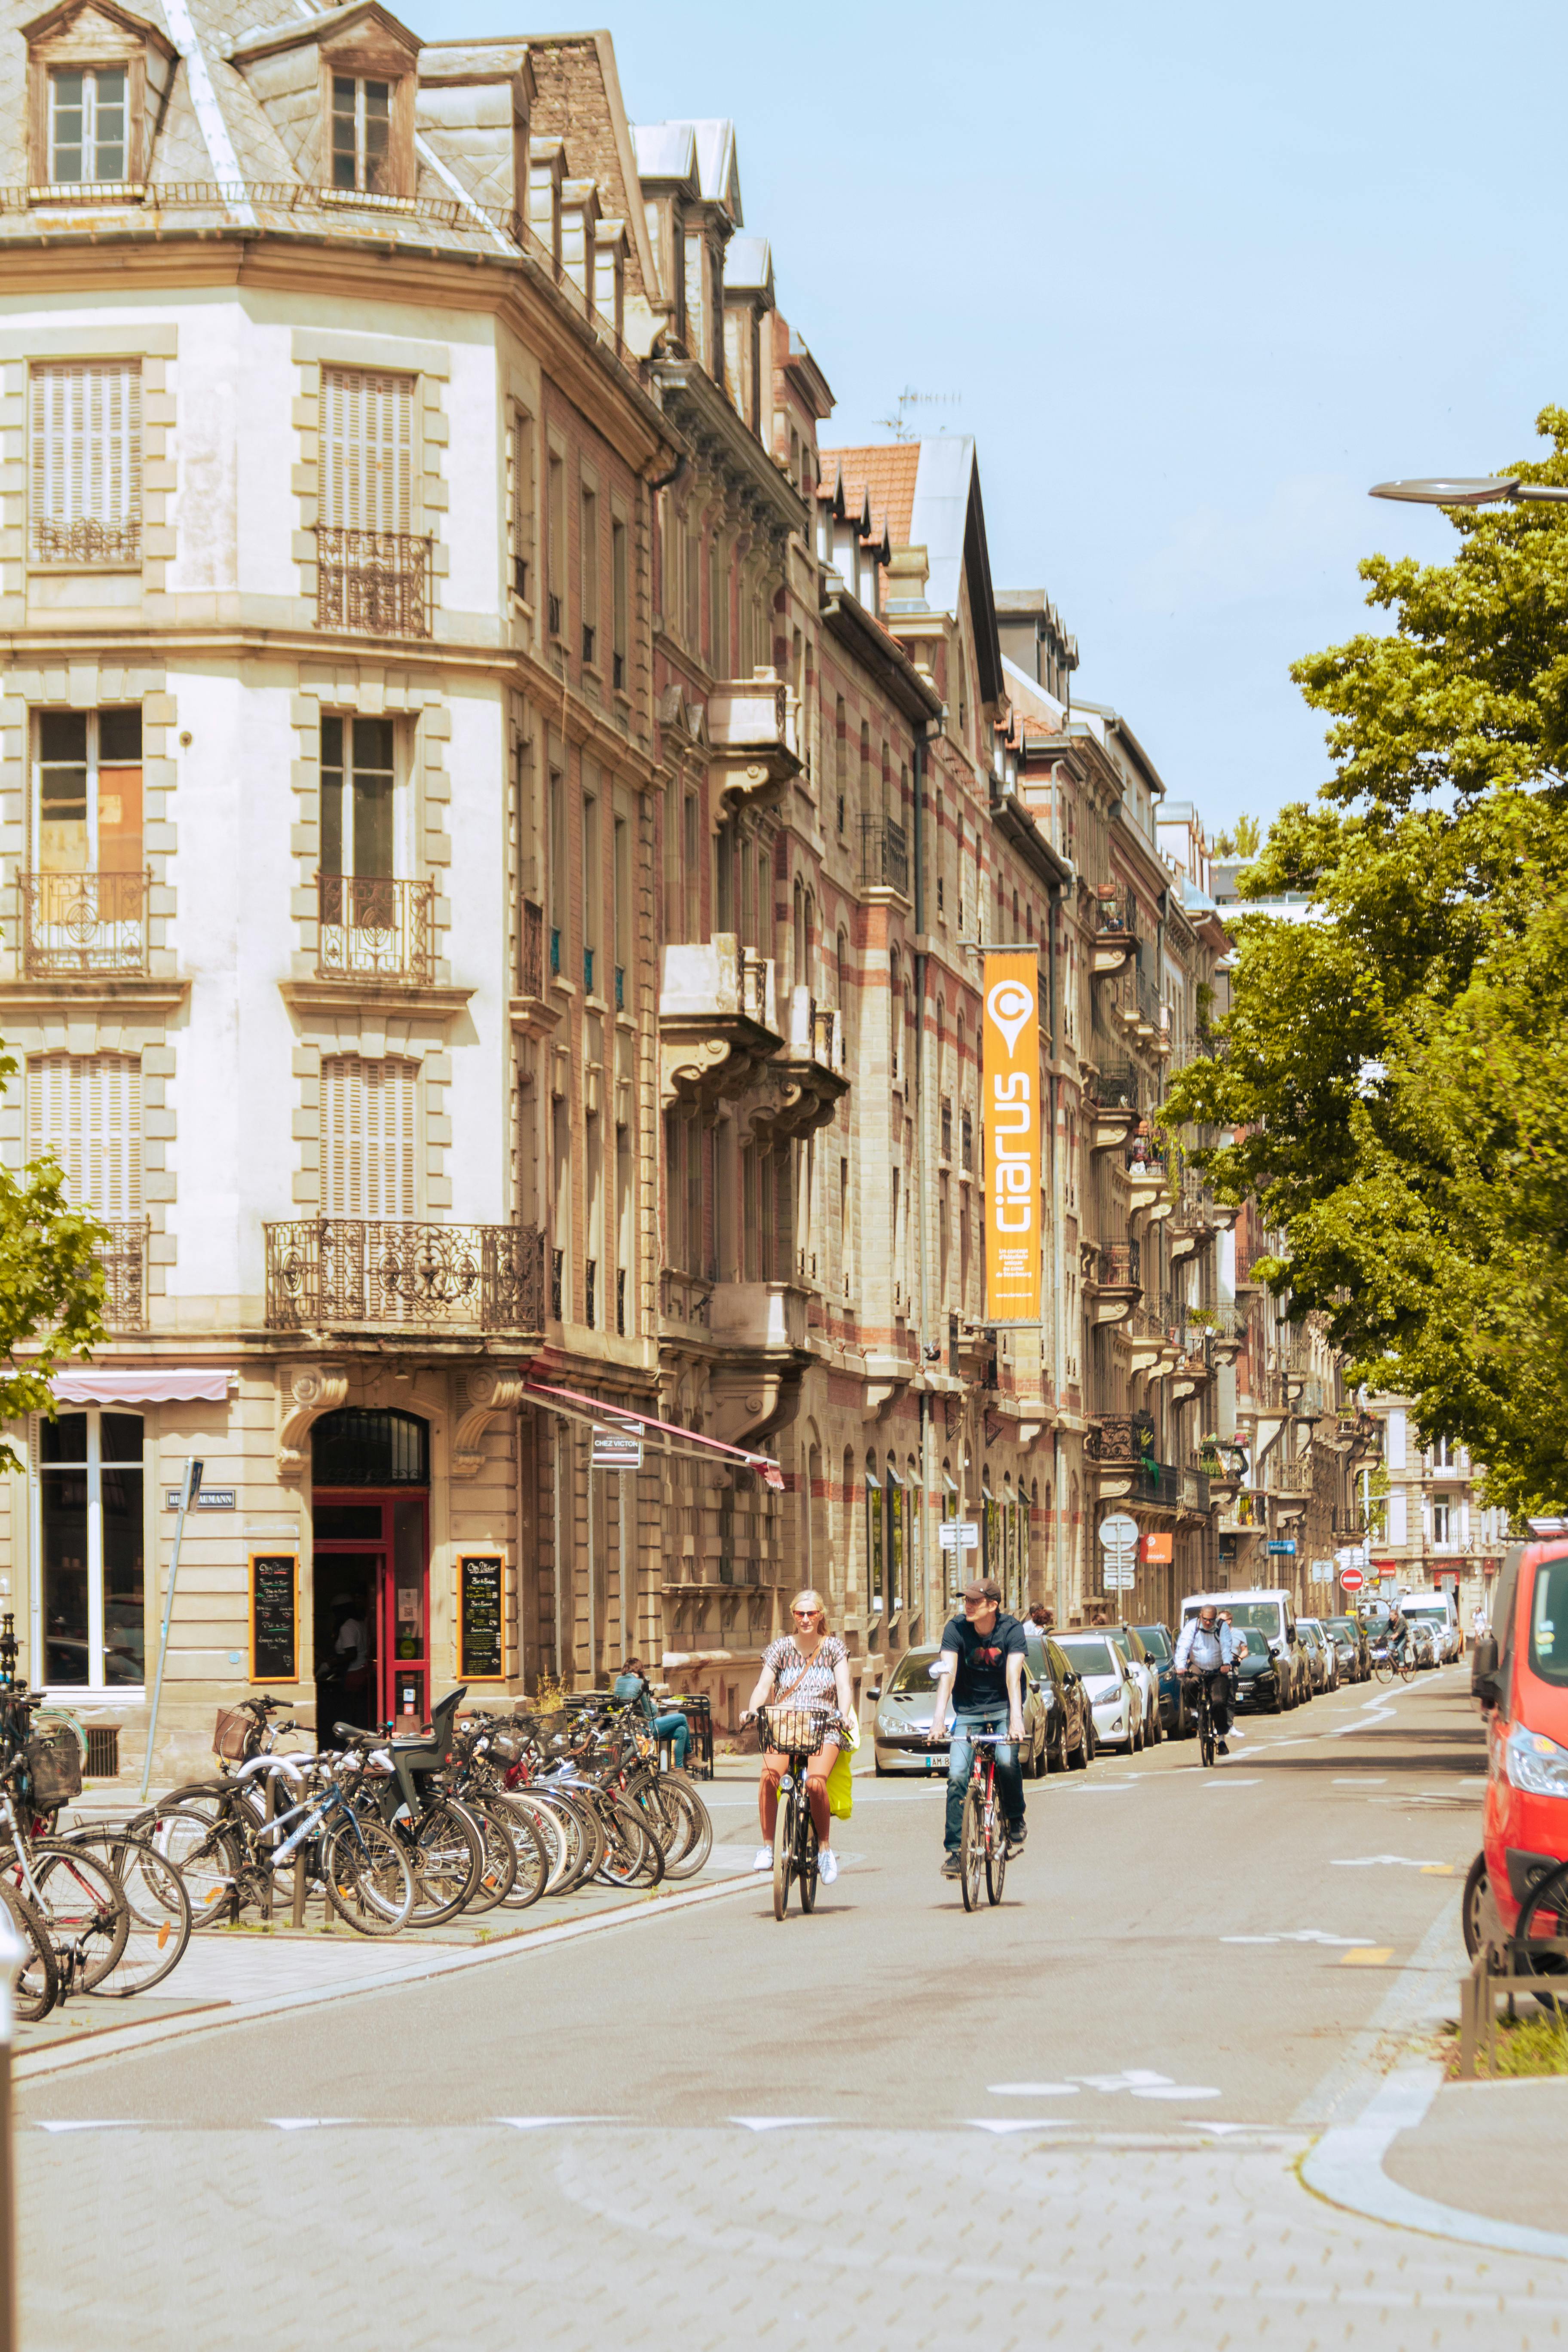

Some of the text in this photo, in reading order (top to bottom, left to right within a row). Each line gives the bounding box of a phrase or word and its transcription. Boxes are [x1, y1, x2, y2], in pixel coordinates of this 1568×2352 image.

[994, 1072, 1031, 1232] ciarus
[169, 1495, 233, 1504] RU AUMANN
[292, 1808, 323, 1841] DECATHLON
